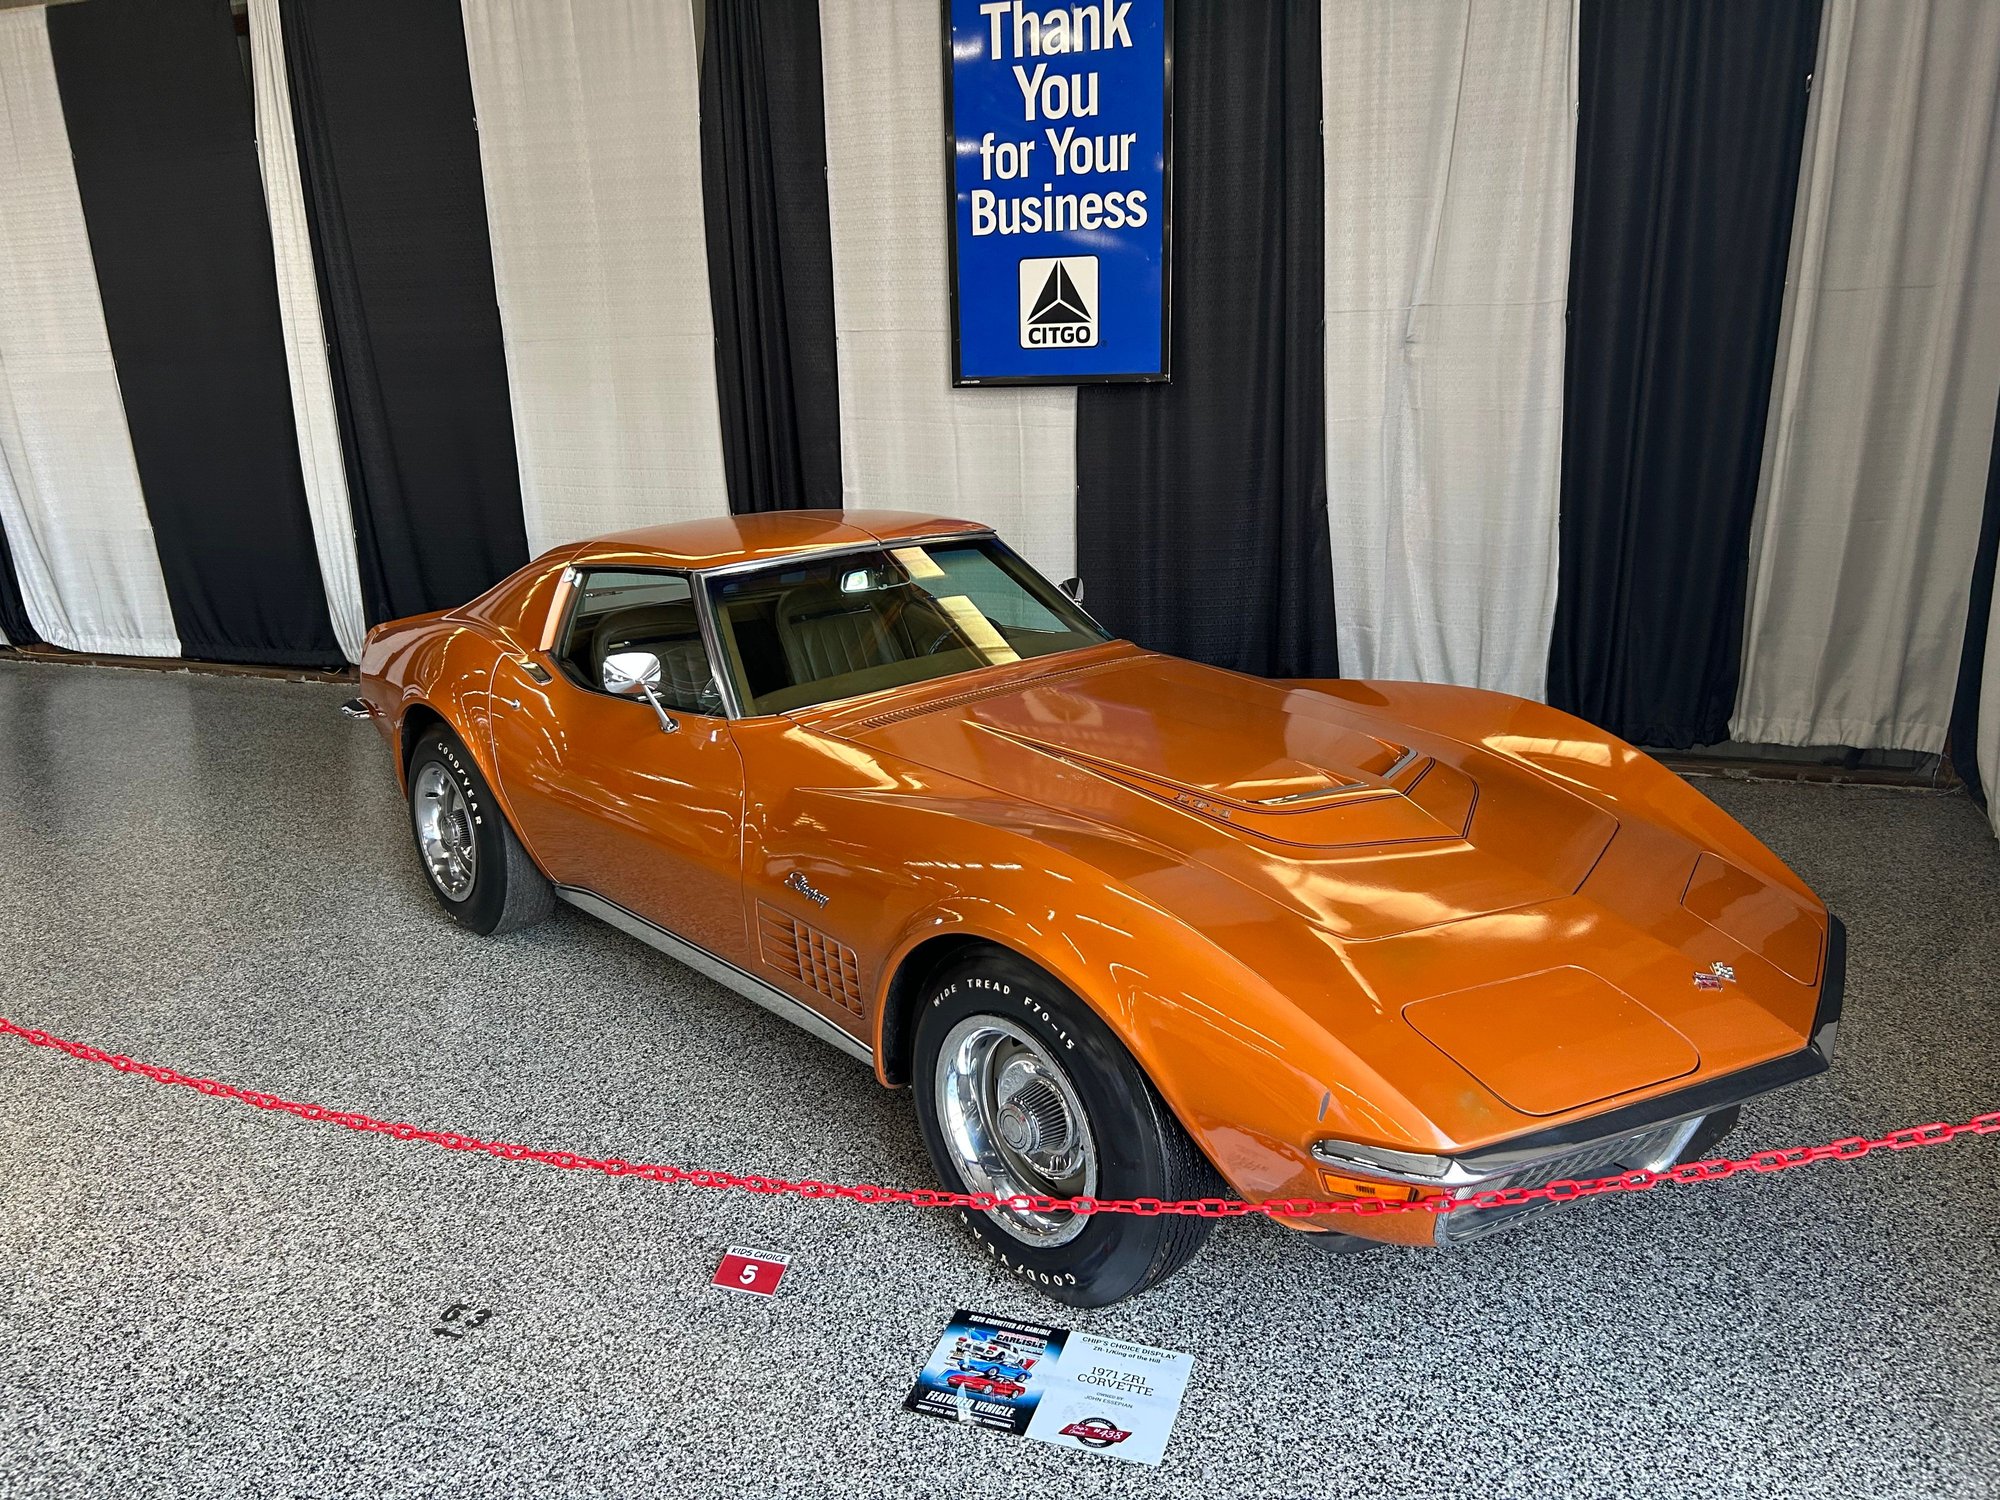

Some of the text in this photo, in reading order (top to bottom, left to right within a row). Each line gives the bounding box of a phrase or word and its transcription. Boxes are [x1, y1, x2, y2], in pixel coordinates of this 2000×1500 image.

[980, 0, 1133, 60] Thank
[1012, 62, 1098, 122] You
[980, 126, 1137, 181] for Your
[971, 183, 1148, 236] Business
[1028, 325, 1091, 345] CITGO
[438, 742, 482, 825] GOODYEAR
[933, 978, 1075, 1050] WIDE TREAD F70-15
[731, 1247, 786, 1263] KIDS CHOICE
[739, 1264, 759, 1285] 5
[996, 1334, 1046, 1349] CARLISLE
[1082, 1336, 1177, 1360] CHIP'S CHOICE DISPLAY
[1149, 1356, 1161, 1364] Hill
[1077, 1373, 1154, 1397] CORVETTE
[1091, 1366, 1146, 1385] 1971 ZR1
[974, 1400, 1016, 1418] VEHICLE
